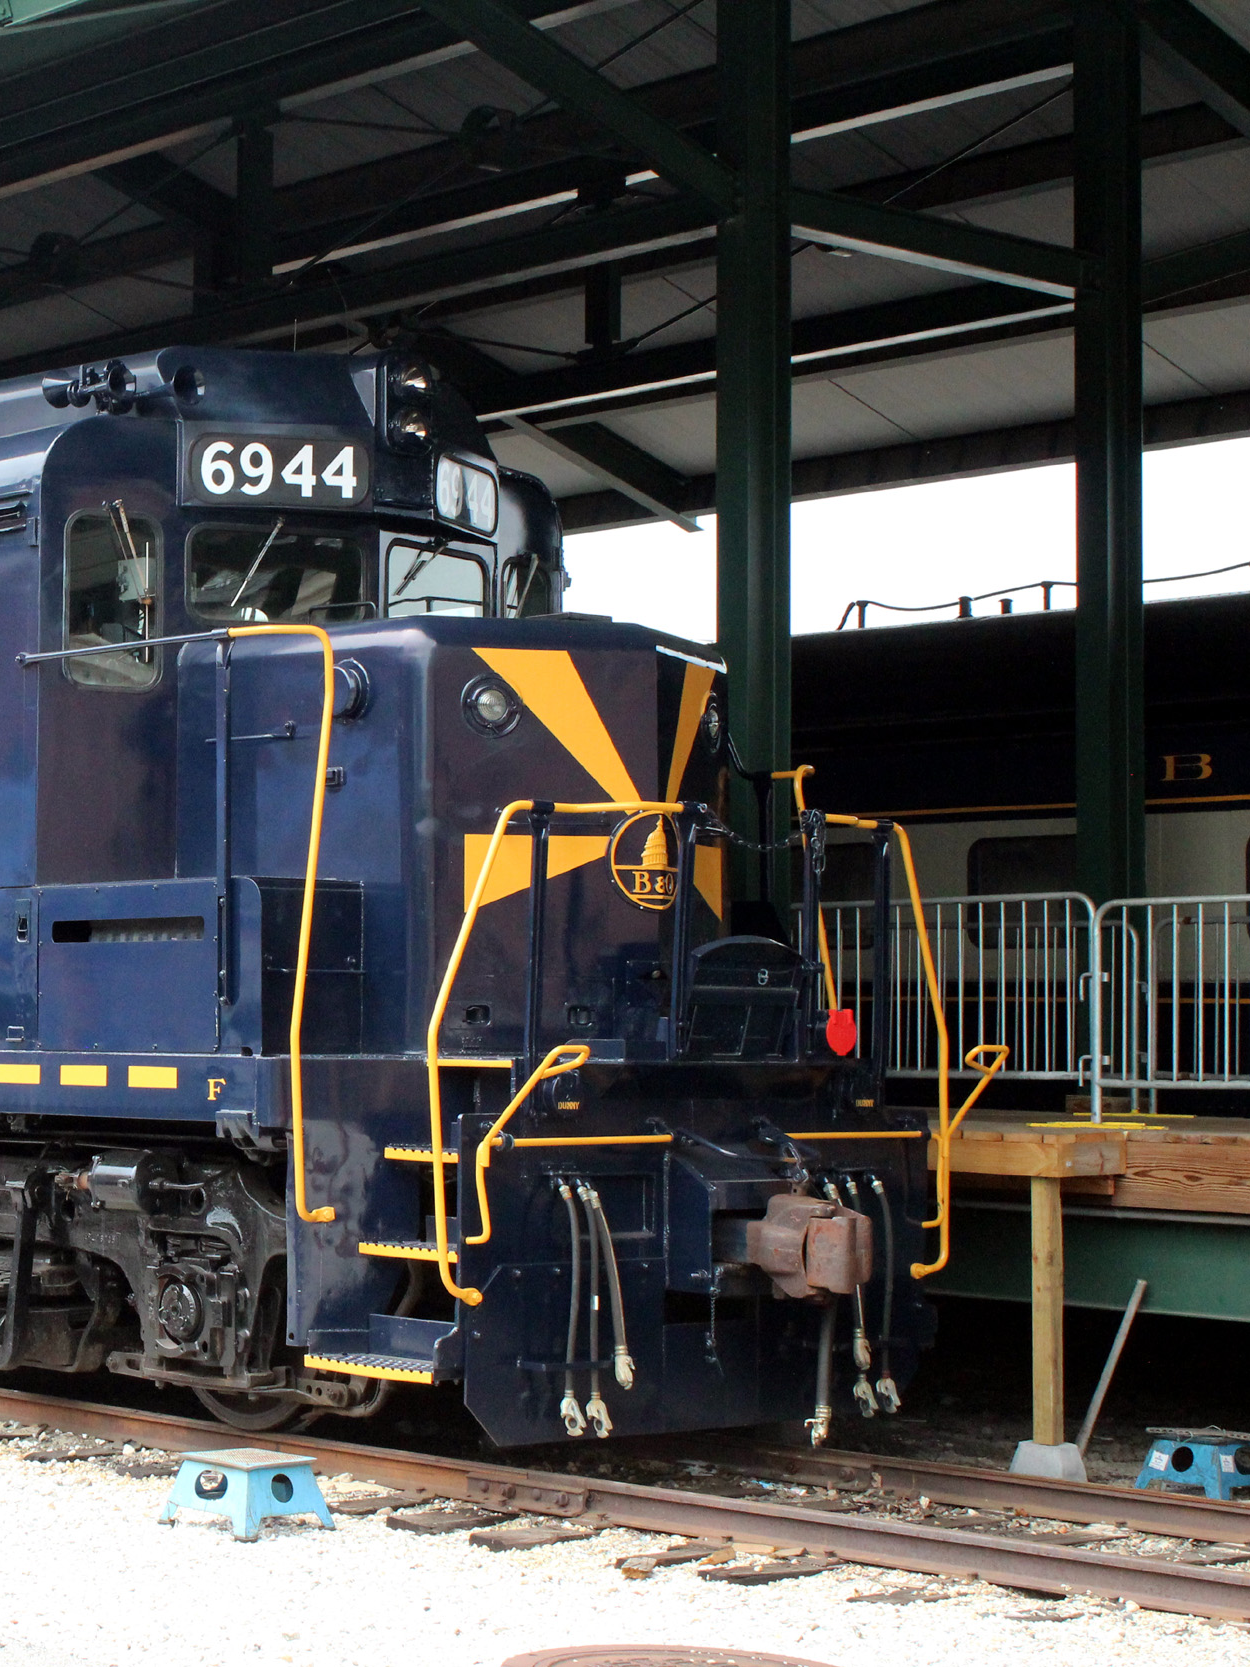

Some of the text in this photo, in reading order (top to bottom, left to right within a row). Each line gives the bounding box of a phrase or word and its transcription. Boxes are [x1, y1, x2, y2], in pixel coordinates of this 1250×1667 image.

[201, 441, 357, 498] 6944
[439, 462, 494, 529] 6944
[1158, 753, 1212, 781] B
[632, 871, 674, 895] B&O
[207, 1078, 227, 1101] F
